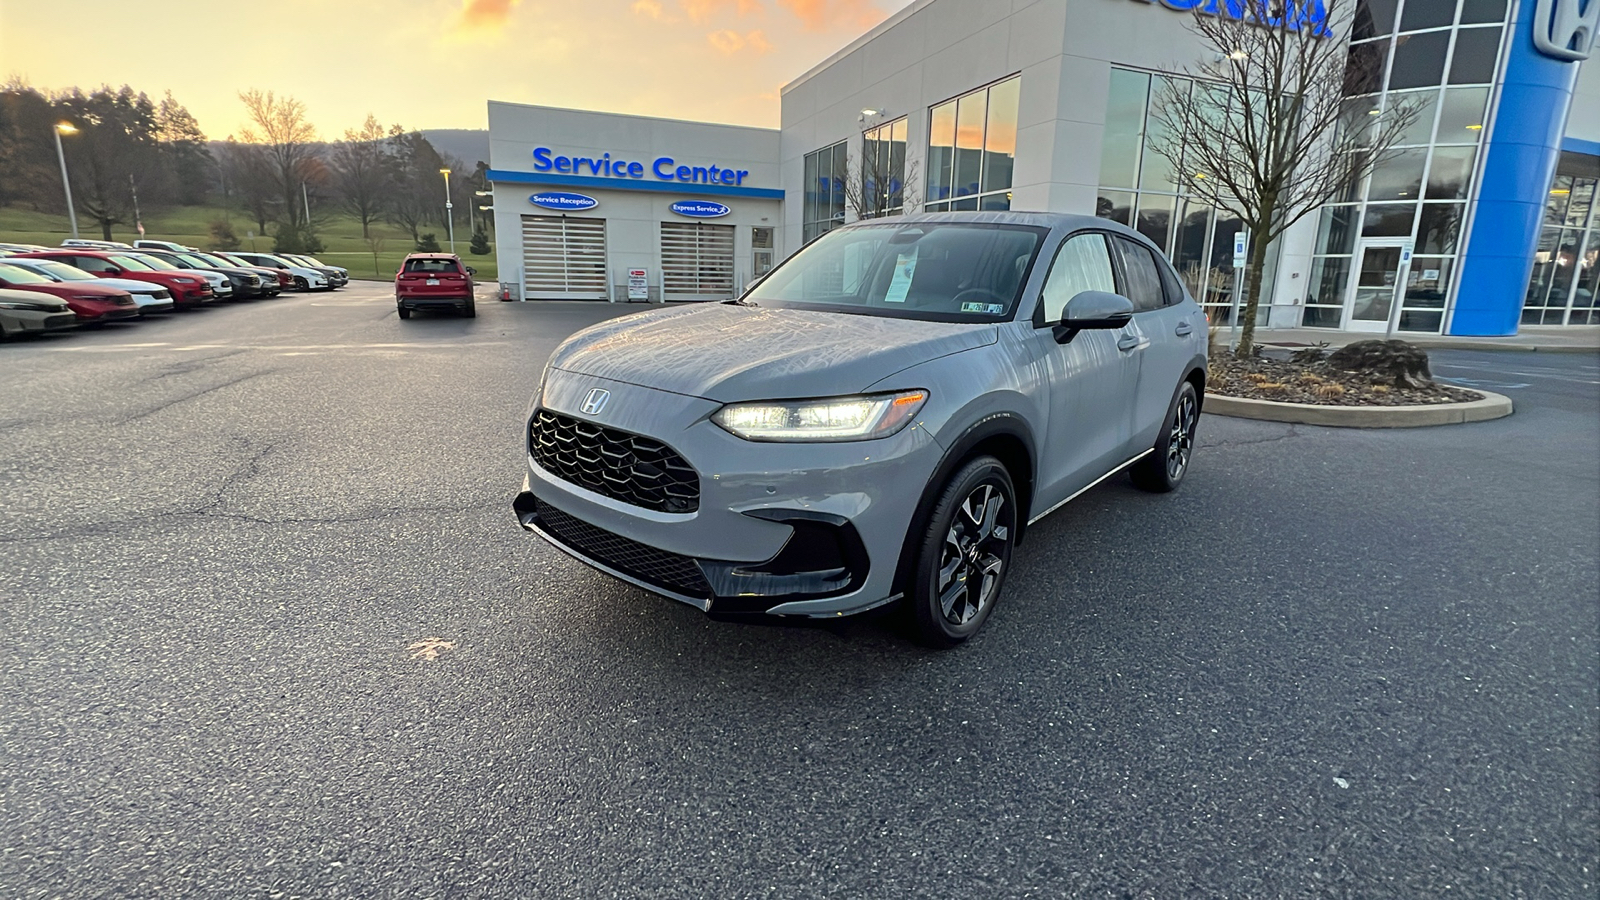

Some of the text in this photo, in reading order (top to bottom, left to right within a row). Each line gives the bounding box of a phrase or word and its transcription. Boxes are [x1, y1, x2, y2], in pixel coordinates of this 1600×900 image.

[532, 147, 749, 186] Service Center
[533, 195, 594, 206] Service Reception
[672, 204, 718, 213] Express Service
